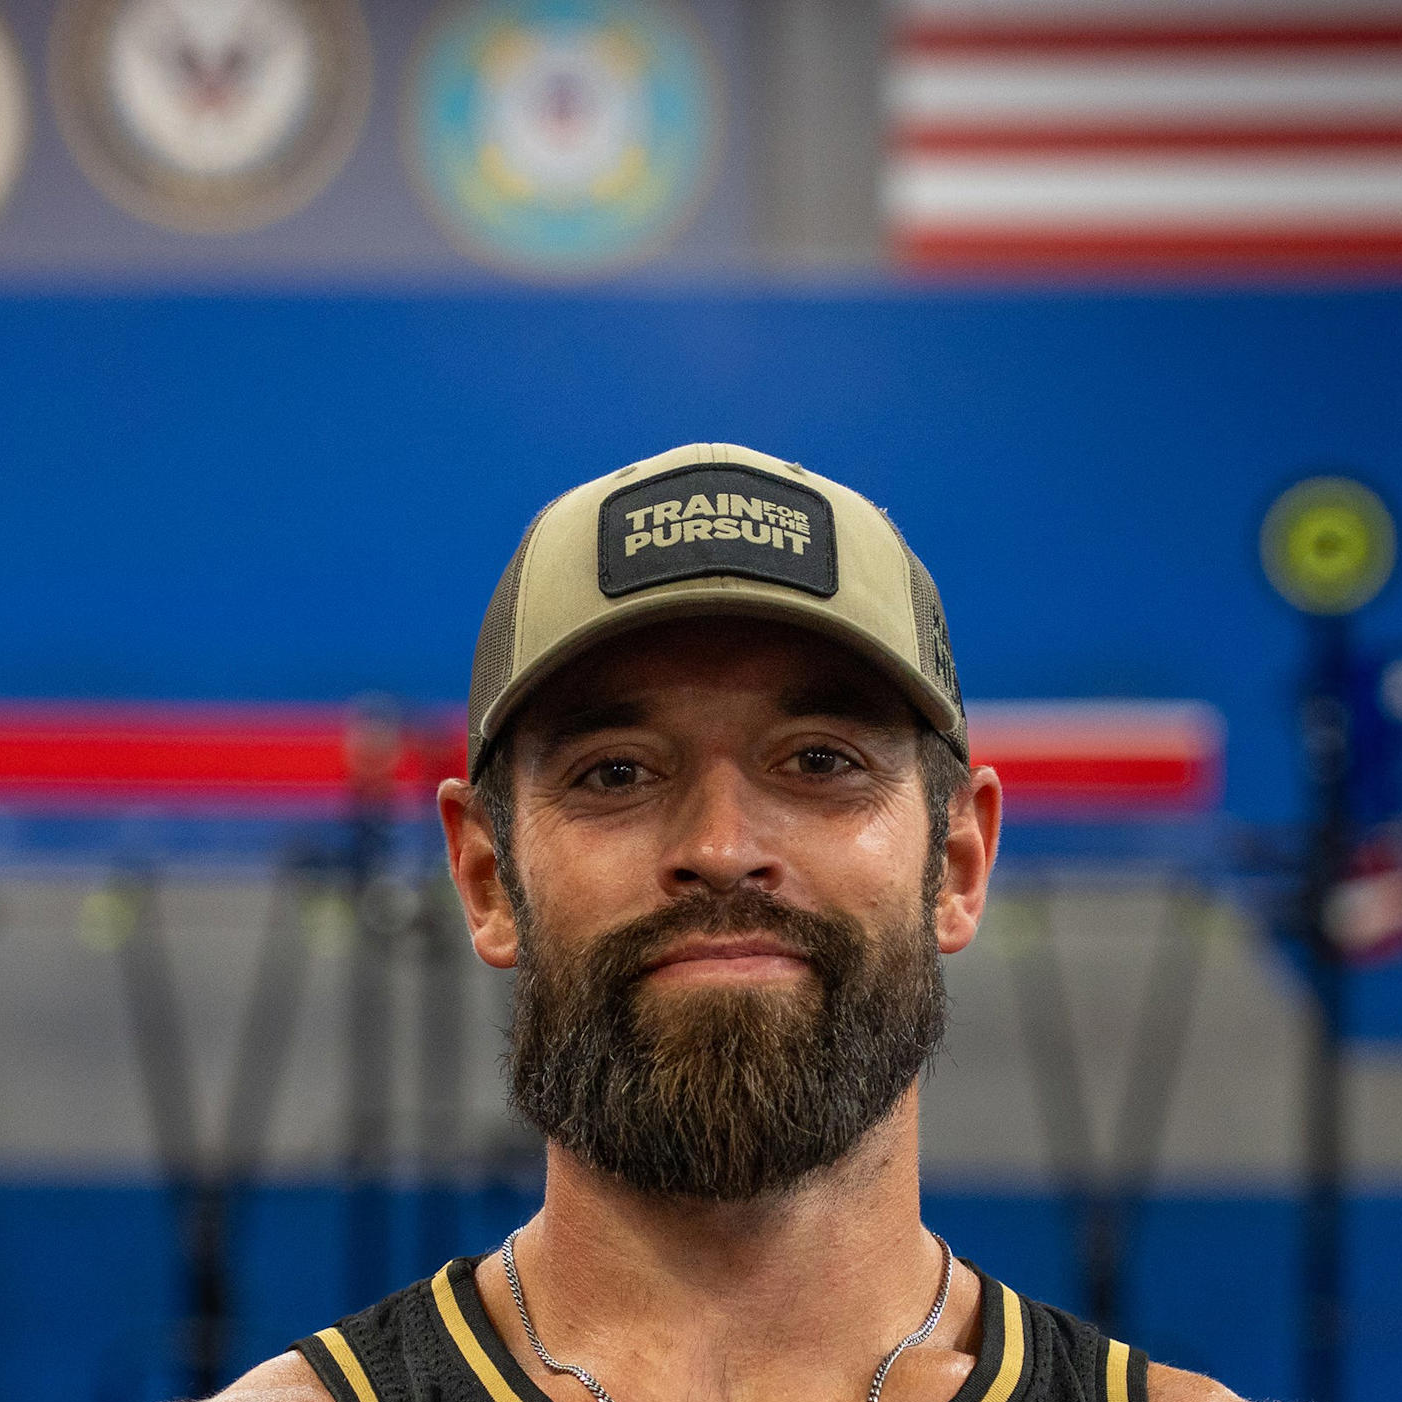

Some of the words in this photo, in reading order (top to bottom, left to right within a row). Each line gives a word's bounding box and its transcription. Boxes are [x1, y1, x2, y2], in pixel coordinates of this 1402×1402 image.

[625, 493, 764, 531] TRAIN
[763, 500, 808, 524] FOR
[764, 513, 810, 537] THE
[625, 518, 812, 557] PURSUIT
